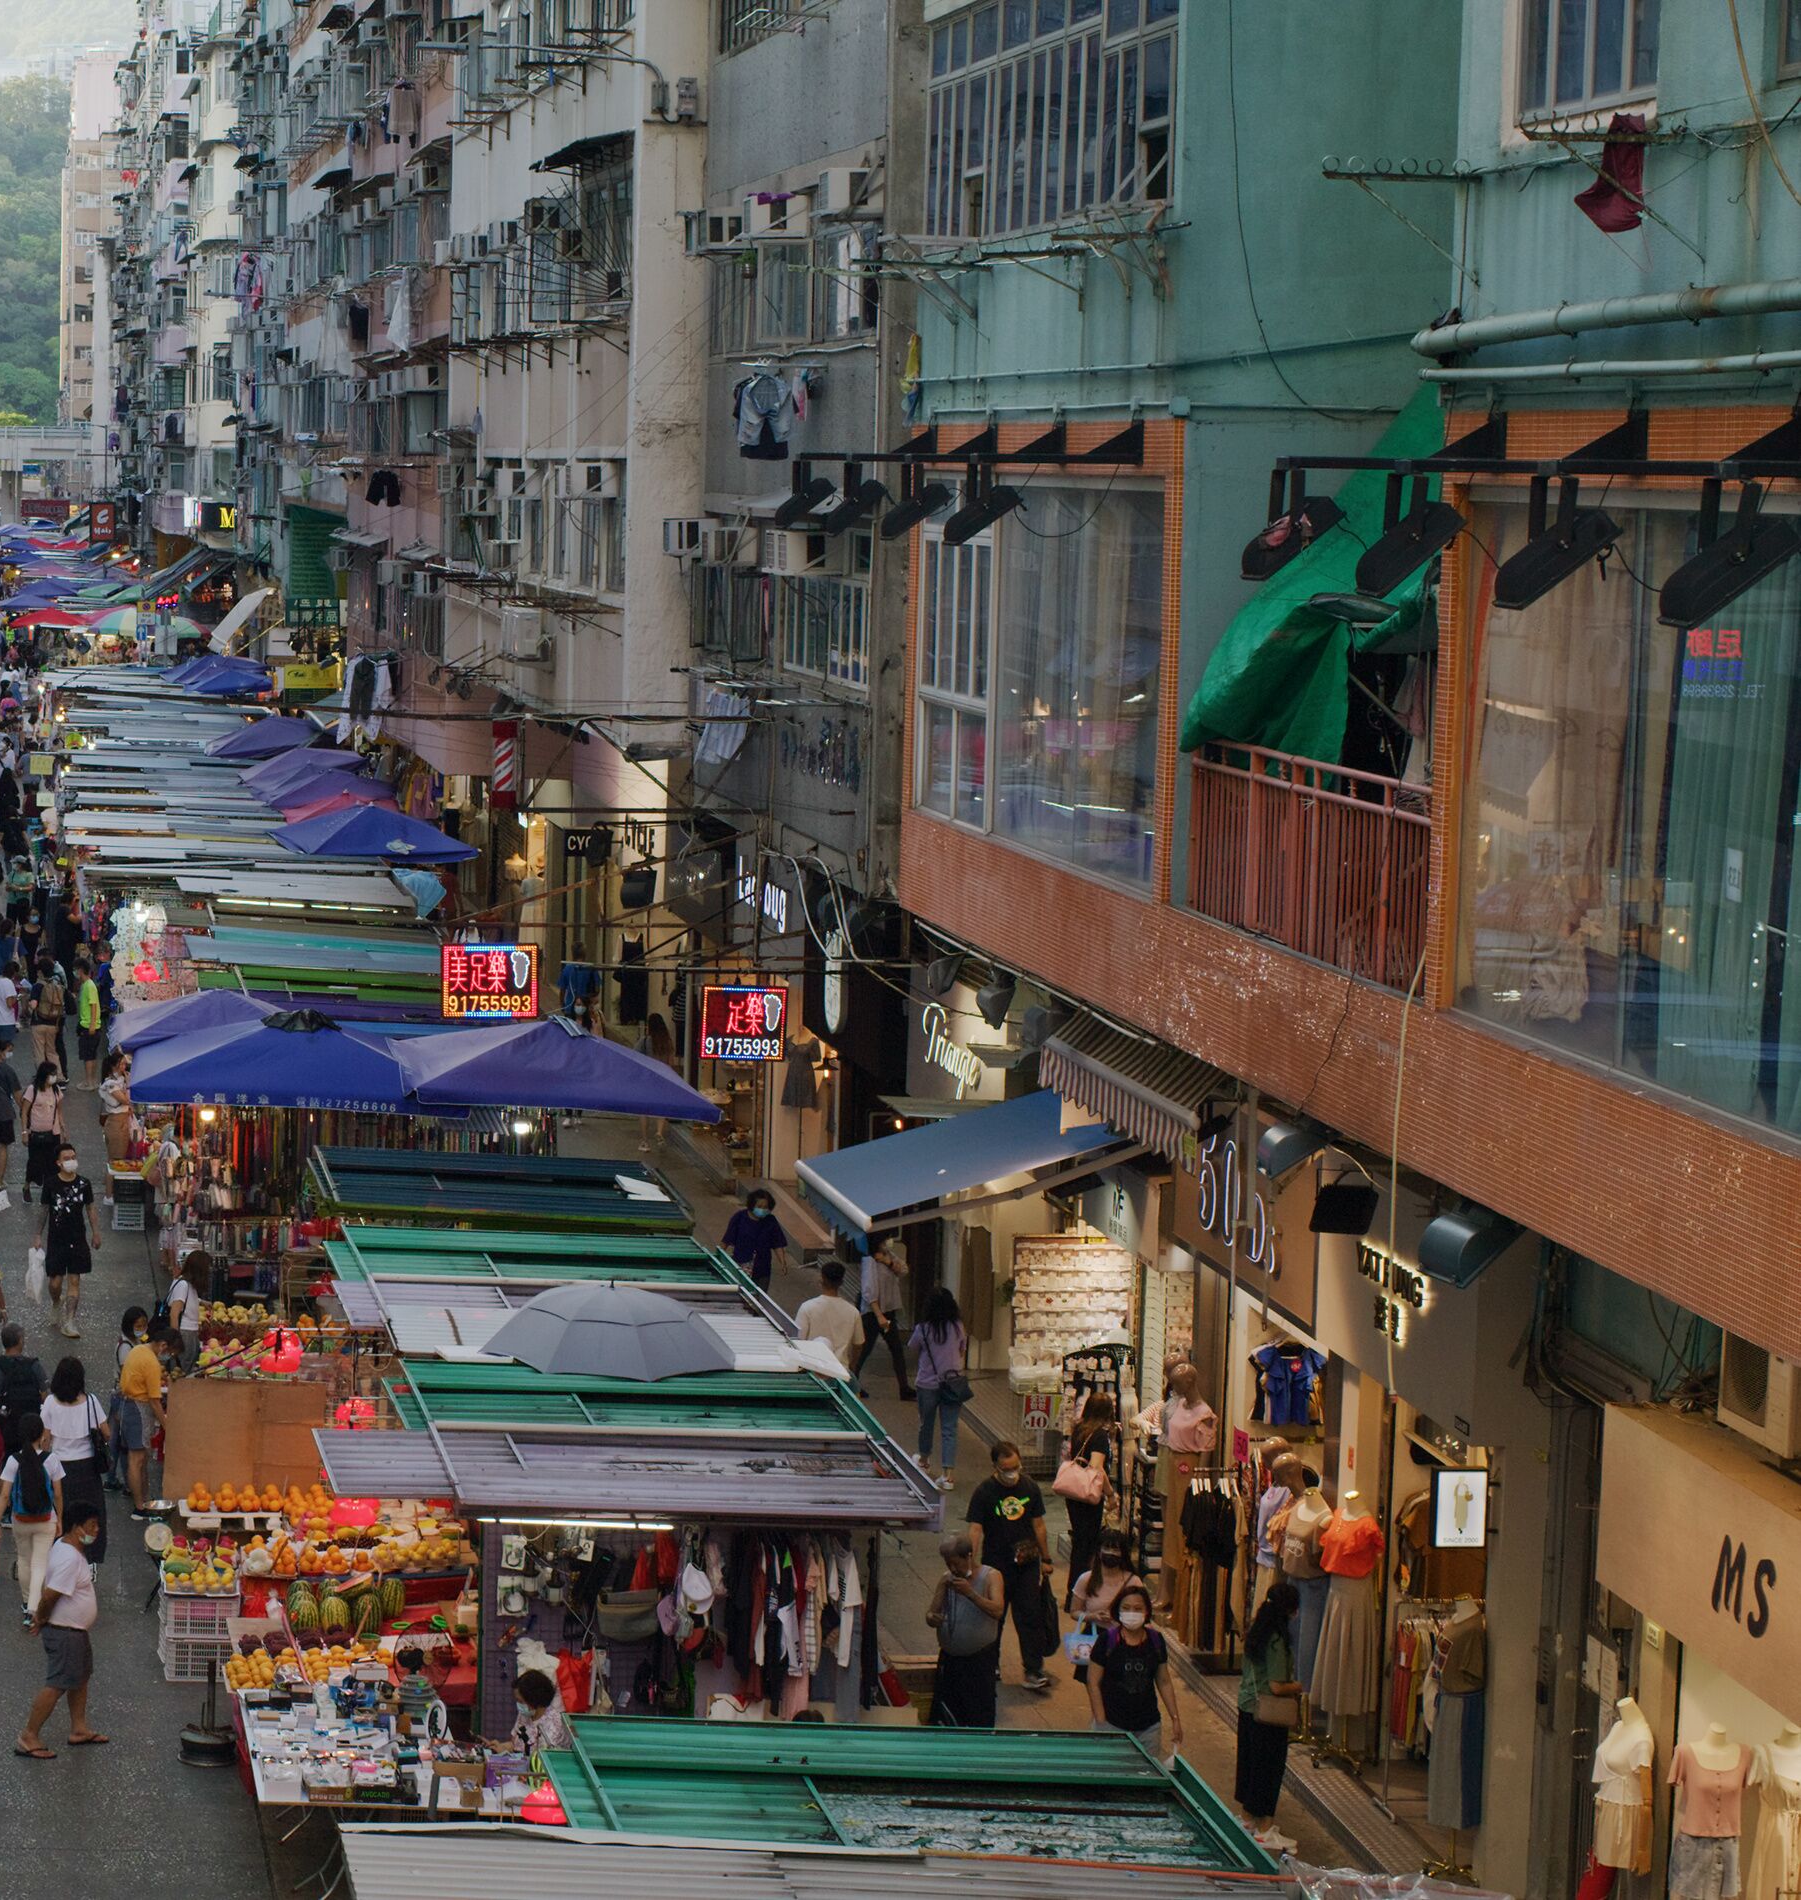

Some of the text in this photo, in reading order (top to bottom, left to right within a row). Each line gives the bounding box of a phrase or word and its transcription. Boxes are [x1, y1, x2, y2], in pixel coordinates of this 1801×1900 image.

[449, 950, 507, 993] 美足樂
[448, 995, 531, 1012] 91755993
[705, 1037, 780, 1057] 91755993
[922, 1002, 980, 1101] Triangle
[1711, 1533, 1777, 1639] MS
[360, 1791, 390, 1799] AVOCADO
